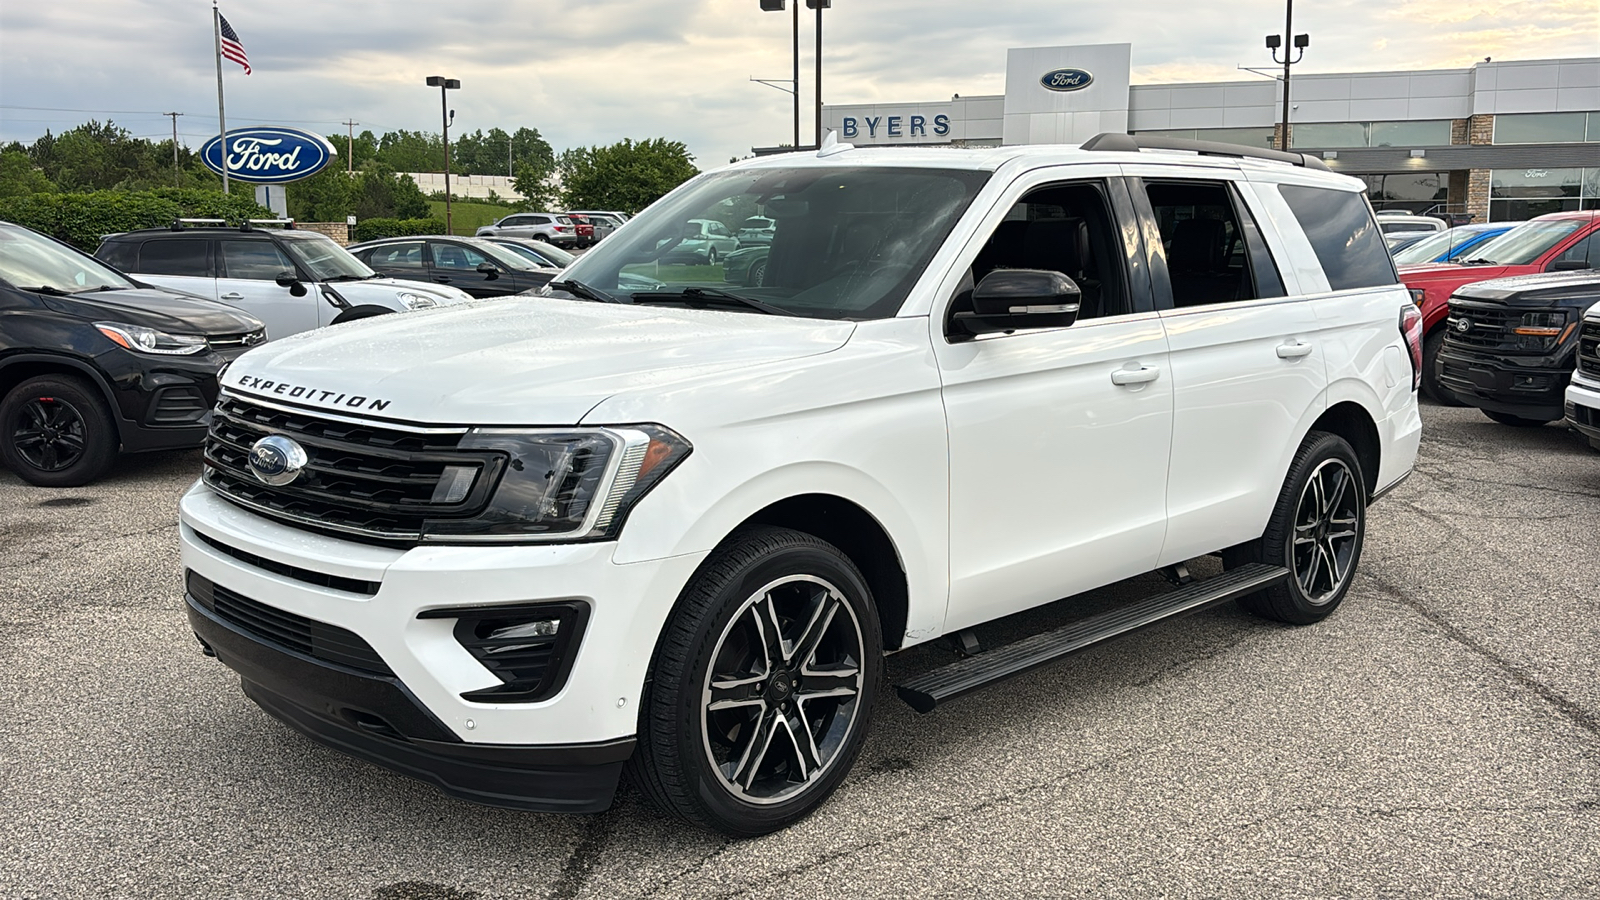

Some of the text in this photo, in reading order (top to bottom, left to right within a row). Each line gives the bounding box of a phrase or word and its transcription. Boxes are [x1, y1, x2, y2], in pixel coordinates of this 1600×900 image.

[1050, 72, 1081, 86] Ford
[843, 114, 951, 138] BYERS
[227, 137, 302, 170] Ford
[1524, 168, 1548, 178] Ford
[238, 375, 392, 411] EXPEDITION
[250, 447, 278, 470] Ford
